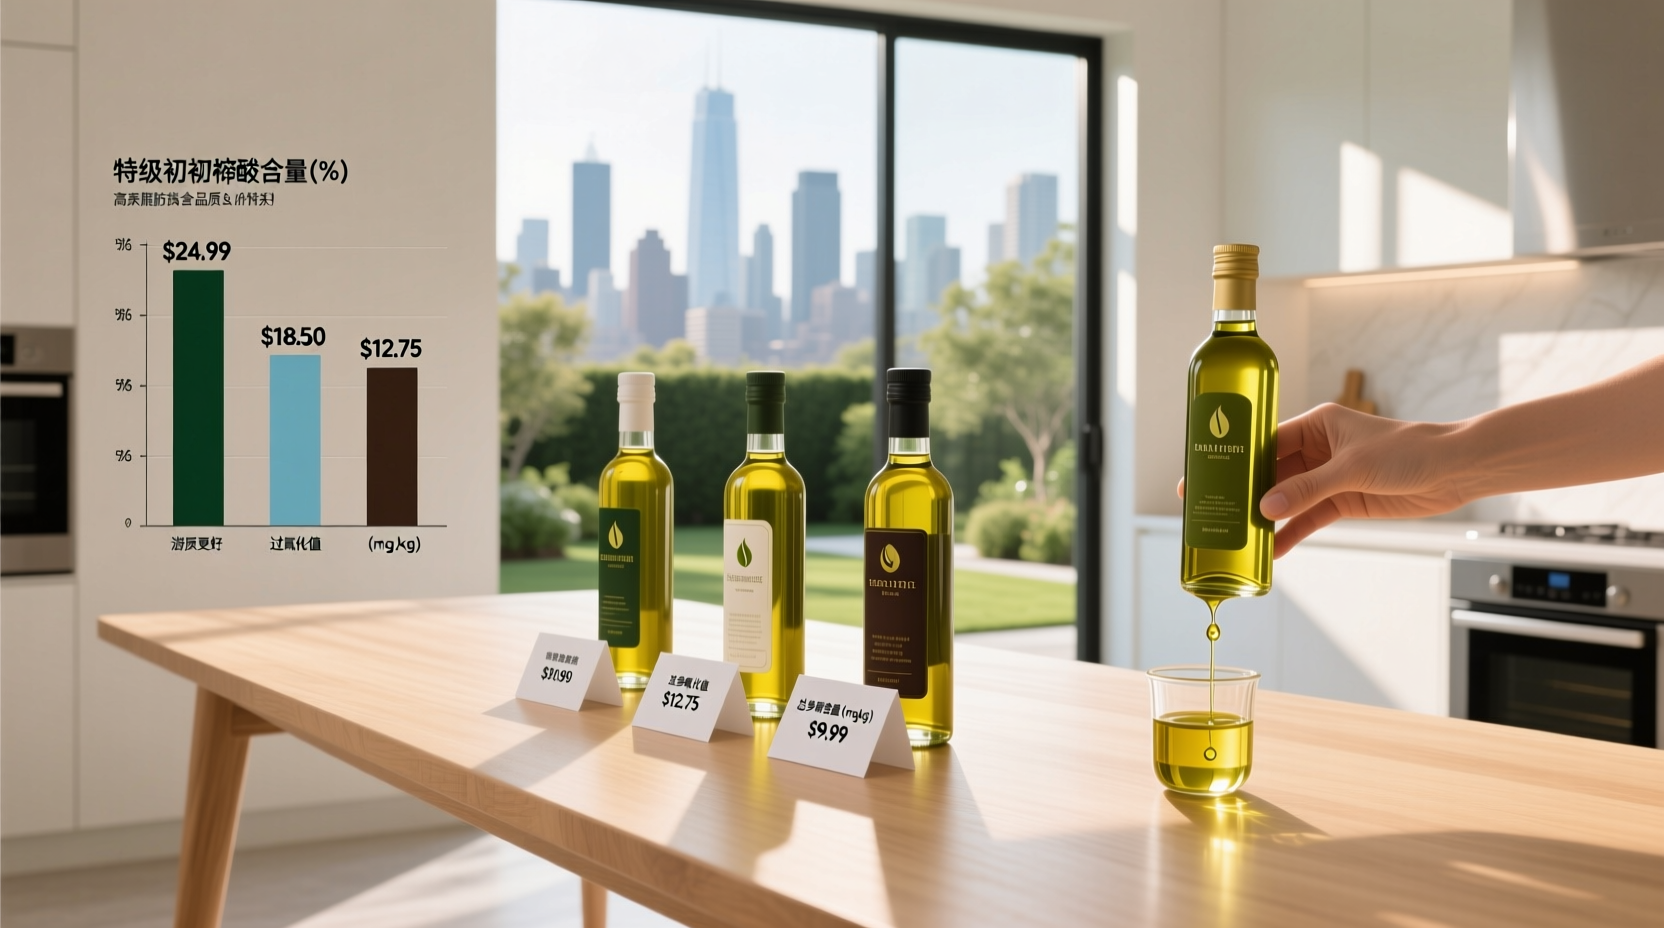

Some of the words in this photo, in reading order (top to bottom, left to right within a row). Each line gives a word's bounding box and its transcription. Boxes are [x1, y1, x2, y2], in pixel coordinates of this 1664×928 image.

[162, 239, 232, 264] $24.99
[260, 324, 326, 349] $18.50
[360, 336, 423, 361] $12.75
[807, 719, 849, 744] $9.99
